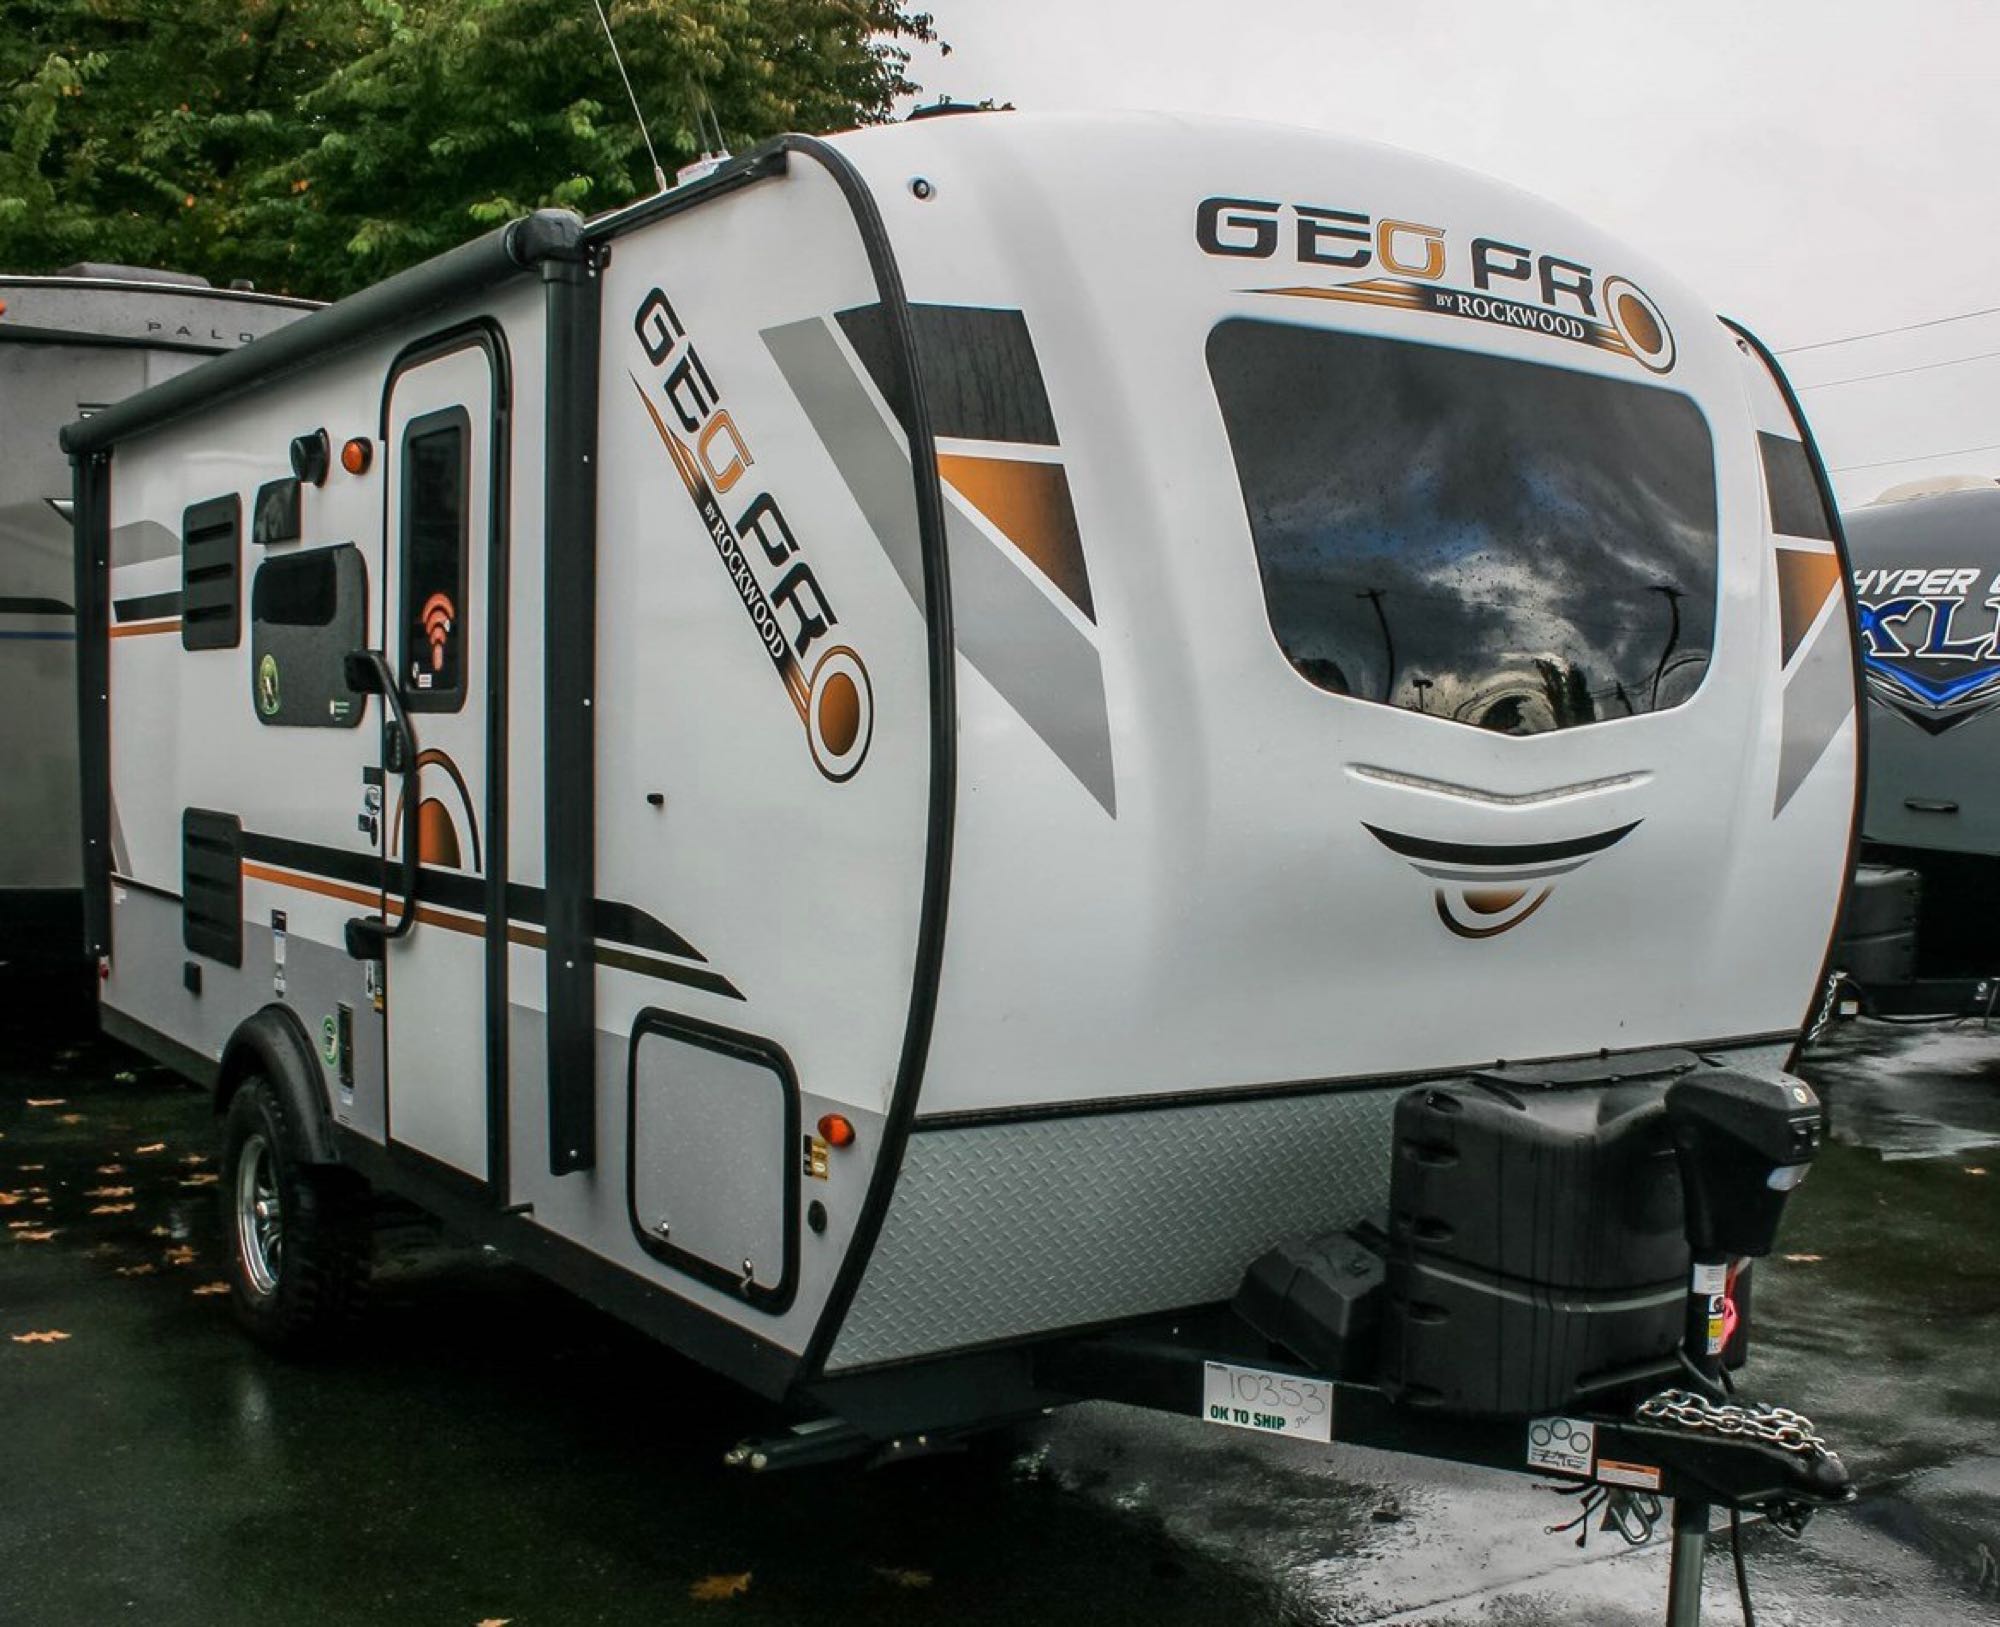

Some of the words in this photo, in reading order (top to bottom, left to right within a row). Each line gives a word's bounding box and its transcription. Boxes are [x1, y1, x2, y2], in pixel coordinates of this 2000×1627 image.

[1197, 197, 1446, 280] GEO
[1471, 238, 1676, 374] PRO
[1436, 293, 1453, 308] BY
[1456, 294, 1585, 339] ROCKWOOD
[635, 287, 755, 493] GEO
[735, 492, 873, 783] PRO
[704, 501, 718, 523] BY
[711, 519, 785, 659] ROCKWOOD
[1853, 569, 1981, 595] HYPER
[1858, 596, 2000, 661] XL
[1210, 1404, 1229, 1421] OK
[1232, 1408, 1249, 1424] TO
[1253, 1412, 1287, 1430] SHIP
[1230, 1371, 1326, 1416] 10353
